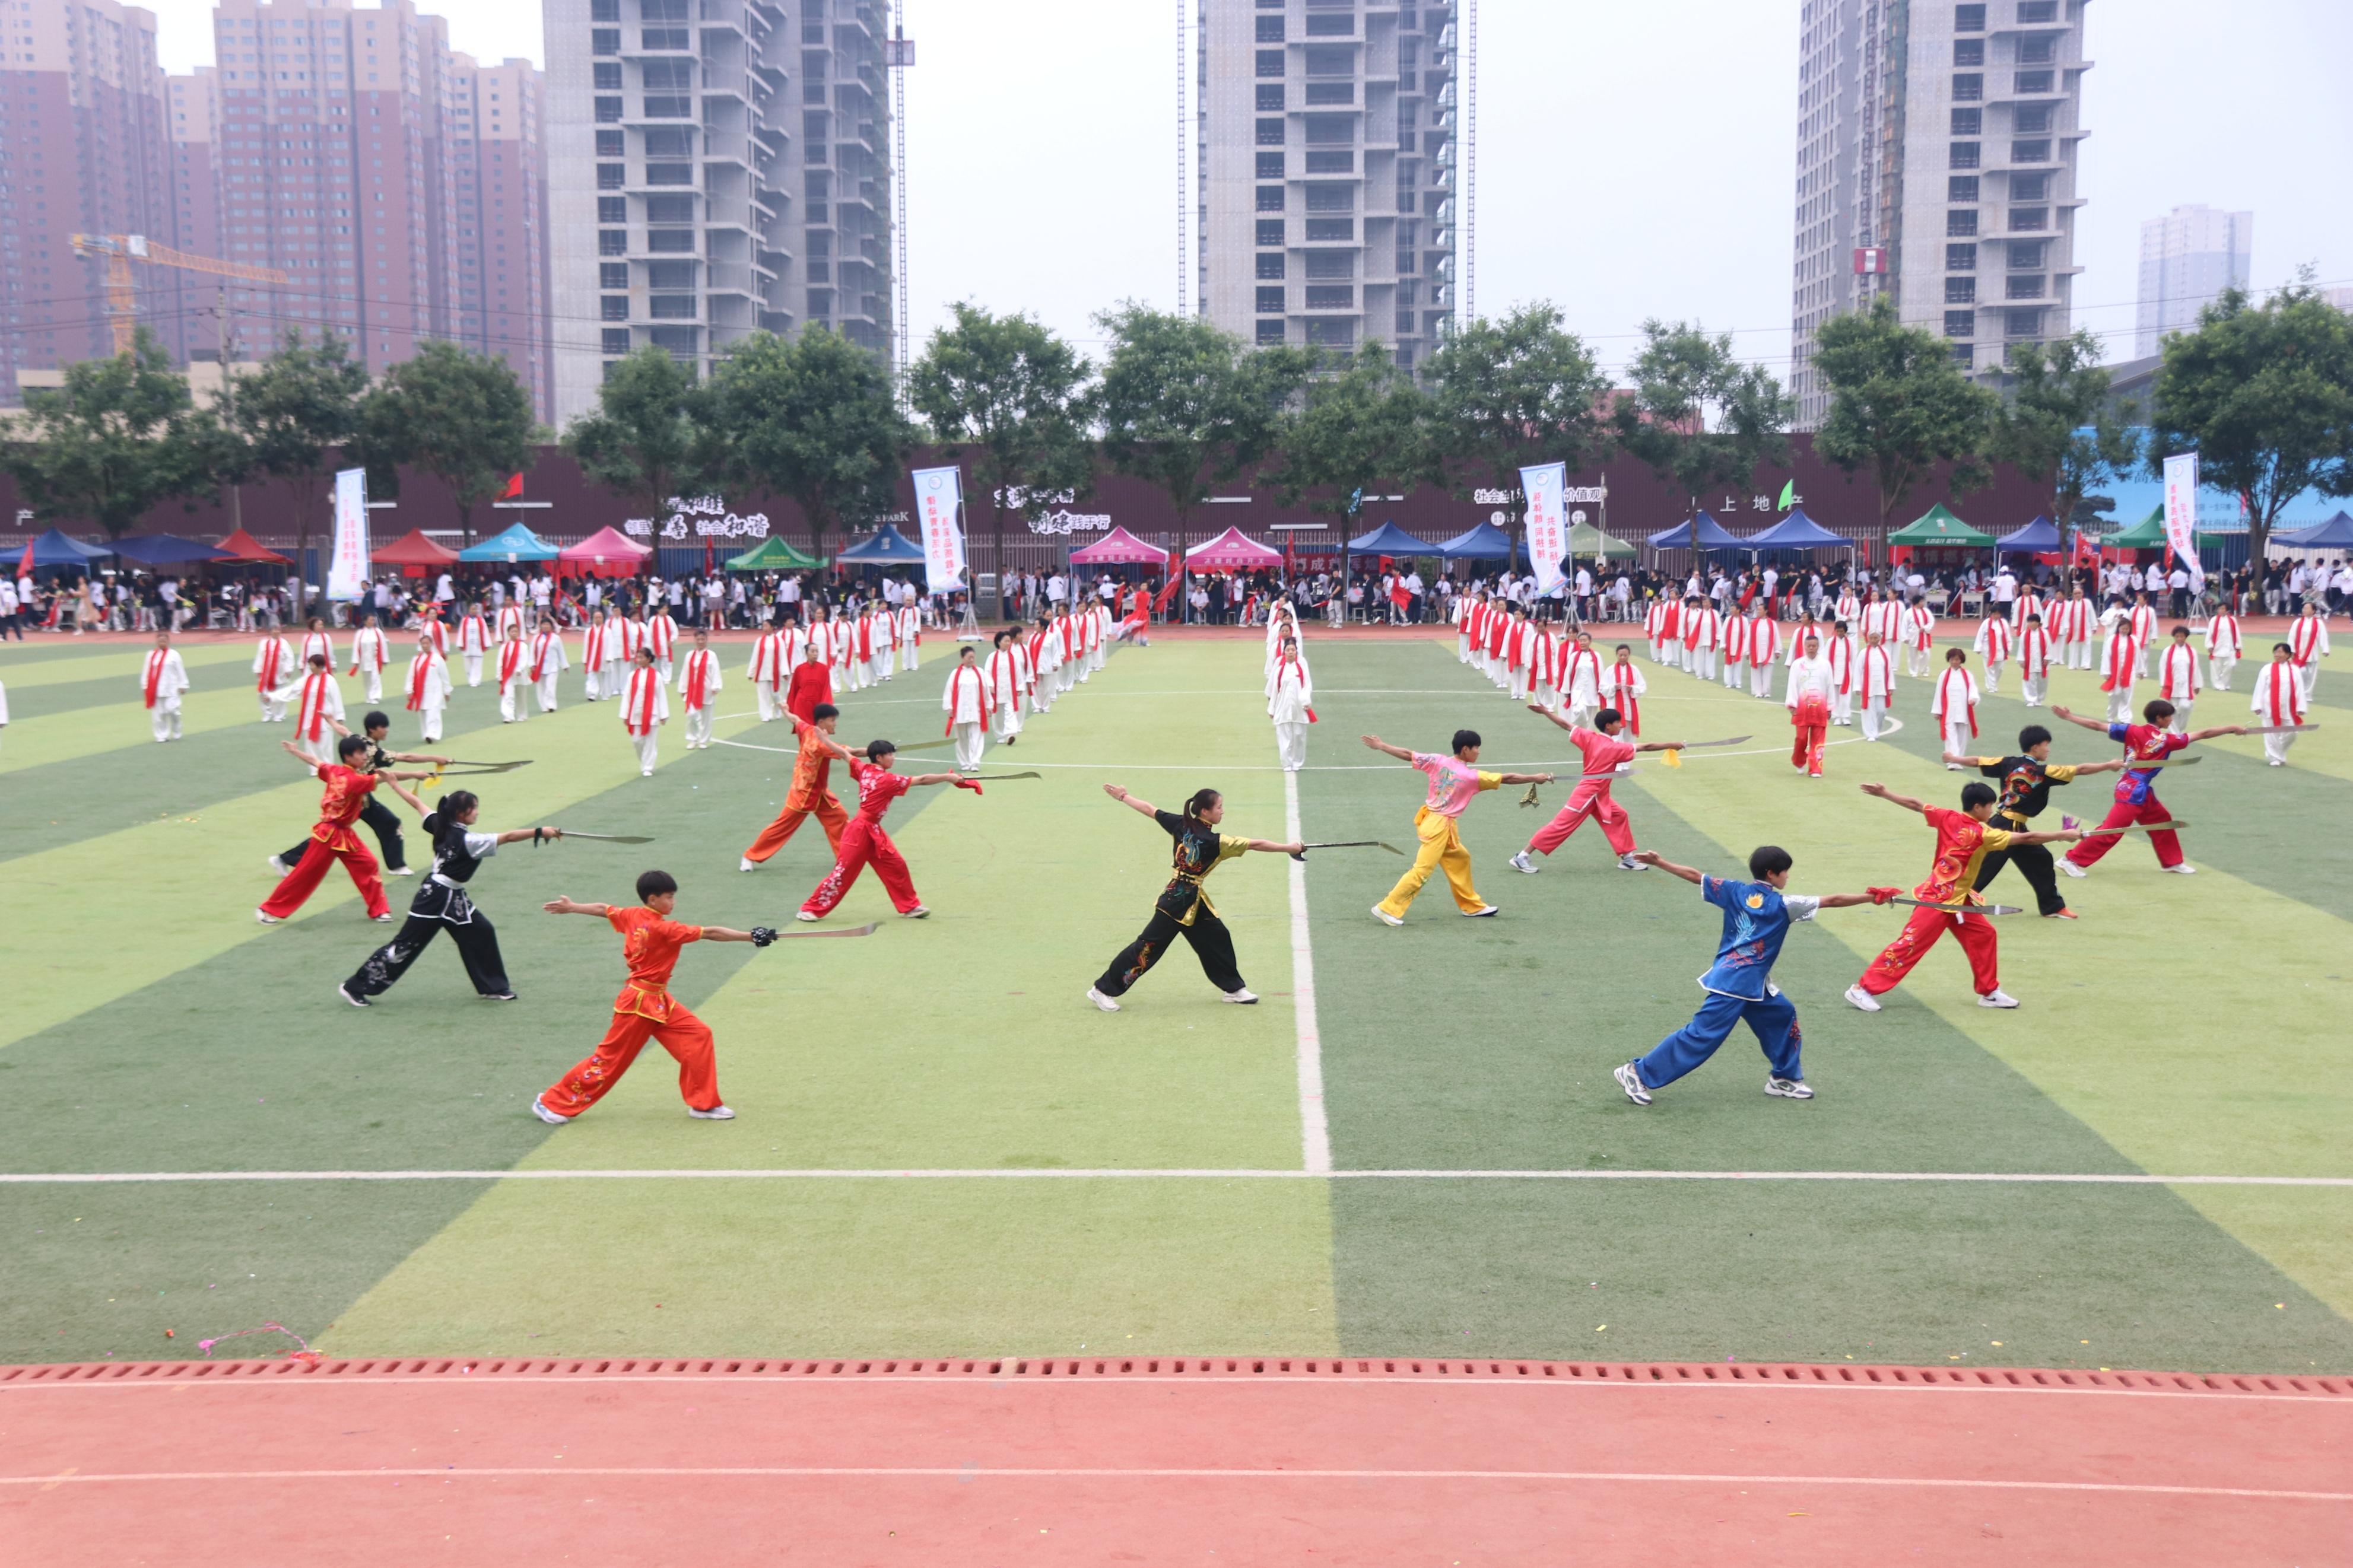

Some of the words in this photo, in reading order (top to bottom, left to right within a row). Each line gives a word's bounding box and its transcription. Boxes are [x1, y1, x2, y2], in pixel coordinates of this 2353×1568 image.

[625, 514, 688, 540] 邻里善
[696, 513, 770, 538] 社会和谐
